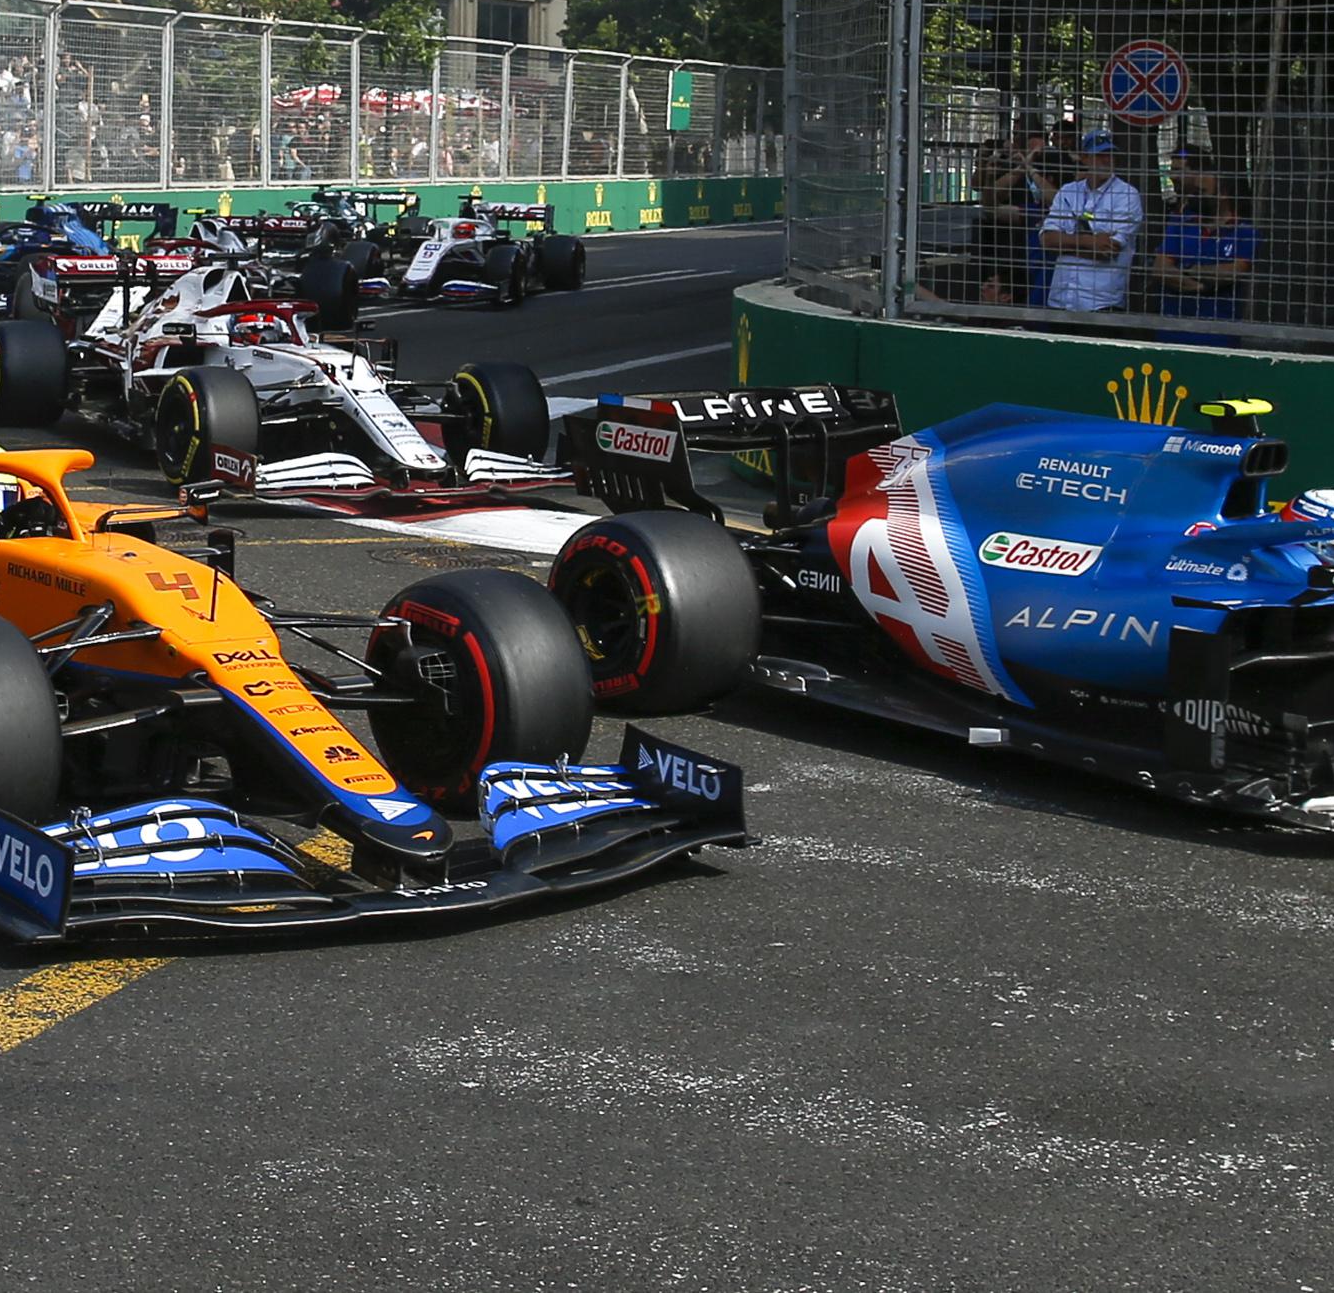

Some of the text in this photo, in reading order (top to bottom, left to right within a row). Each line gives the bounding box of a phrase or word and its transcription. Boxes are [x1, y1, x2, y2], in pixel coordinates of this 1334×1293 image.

[585, 210, 611, 227] ROLEX
[639, 207, 663, 224] ROLEX
[79, 261, 115, 270] ORLEN
[671, 392, 834, 422] LPINE
[613, 427, 671, 457] Castrol
[1184, 439, 1244, 457] Microsoft
[1038, 457, 1112, 480] RENAULT
[1016, 472, 1127, 505] E-TECH
[1005, 540, 1093, 572] Castrol
[1165, 557, 1225, 576] ultimate
[7, 562, 87, 597] RICHARD MILLE
[145, 572, 200, 600] 4
[1004, 606, 1160, 647] ALPIN
[212, 649, 278, 666] DELL
[224, 662, 285, 672] Technologies
[289, 724, 344, 738] Klipsch
[656, 748, 722, 802] VELO
